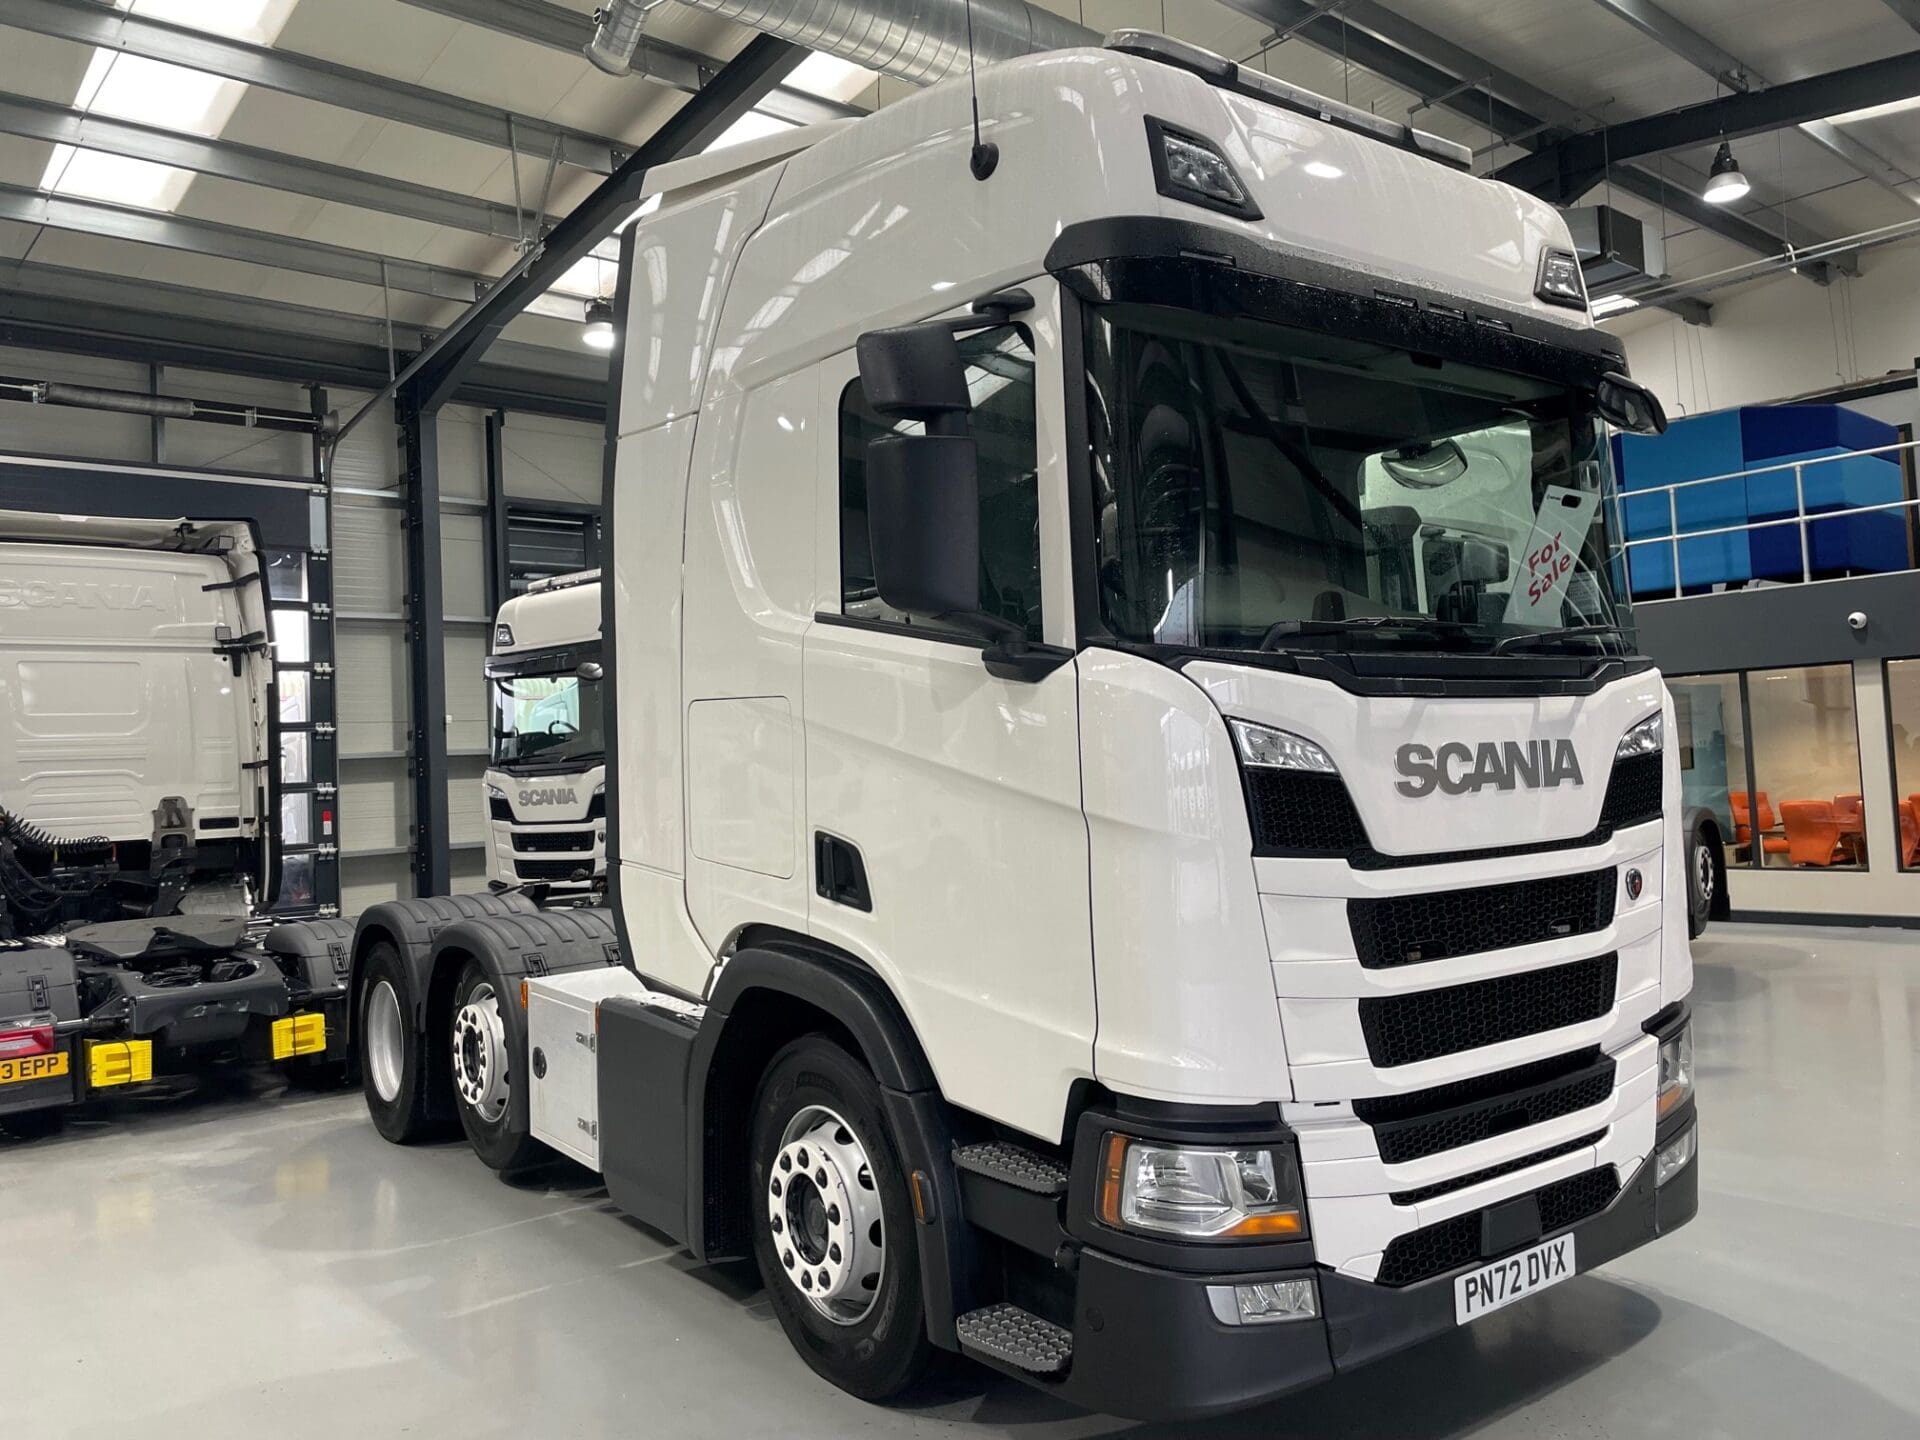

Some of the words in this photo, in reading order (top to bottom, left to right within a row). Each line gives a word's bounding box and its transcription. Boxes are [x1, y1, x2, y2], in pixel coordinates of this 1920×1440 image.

[1528, 531, 1562, 577] For
[1528, 554, 1571, 607] Sale
[1394, 739, 1584, 798] SCANIA
[518, 788, 578, 807] SCANIA
[20, 1056, 59, 1078] EPP
[1465, 1259, 1522, 1313] PN72
[1527, 1241, 1566, 1287] DVX
